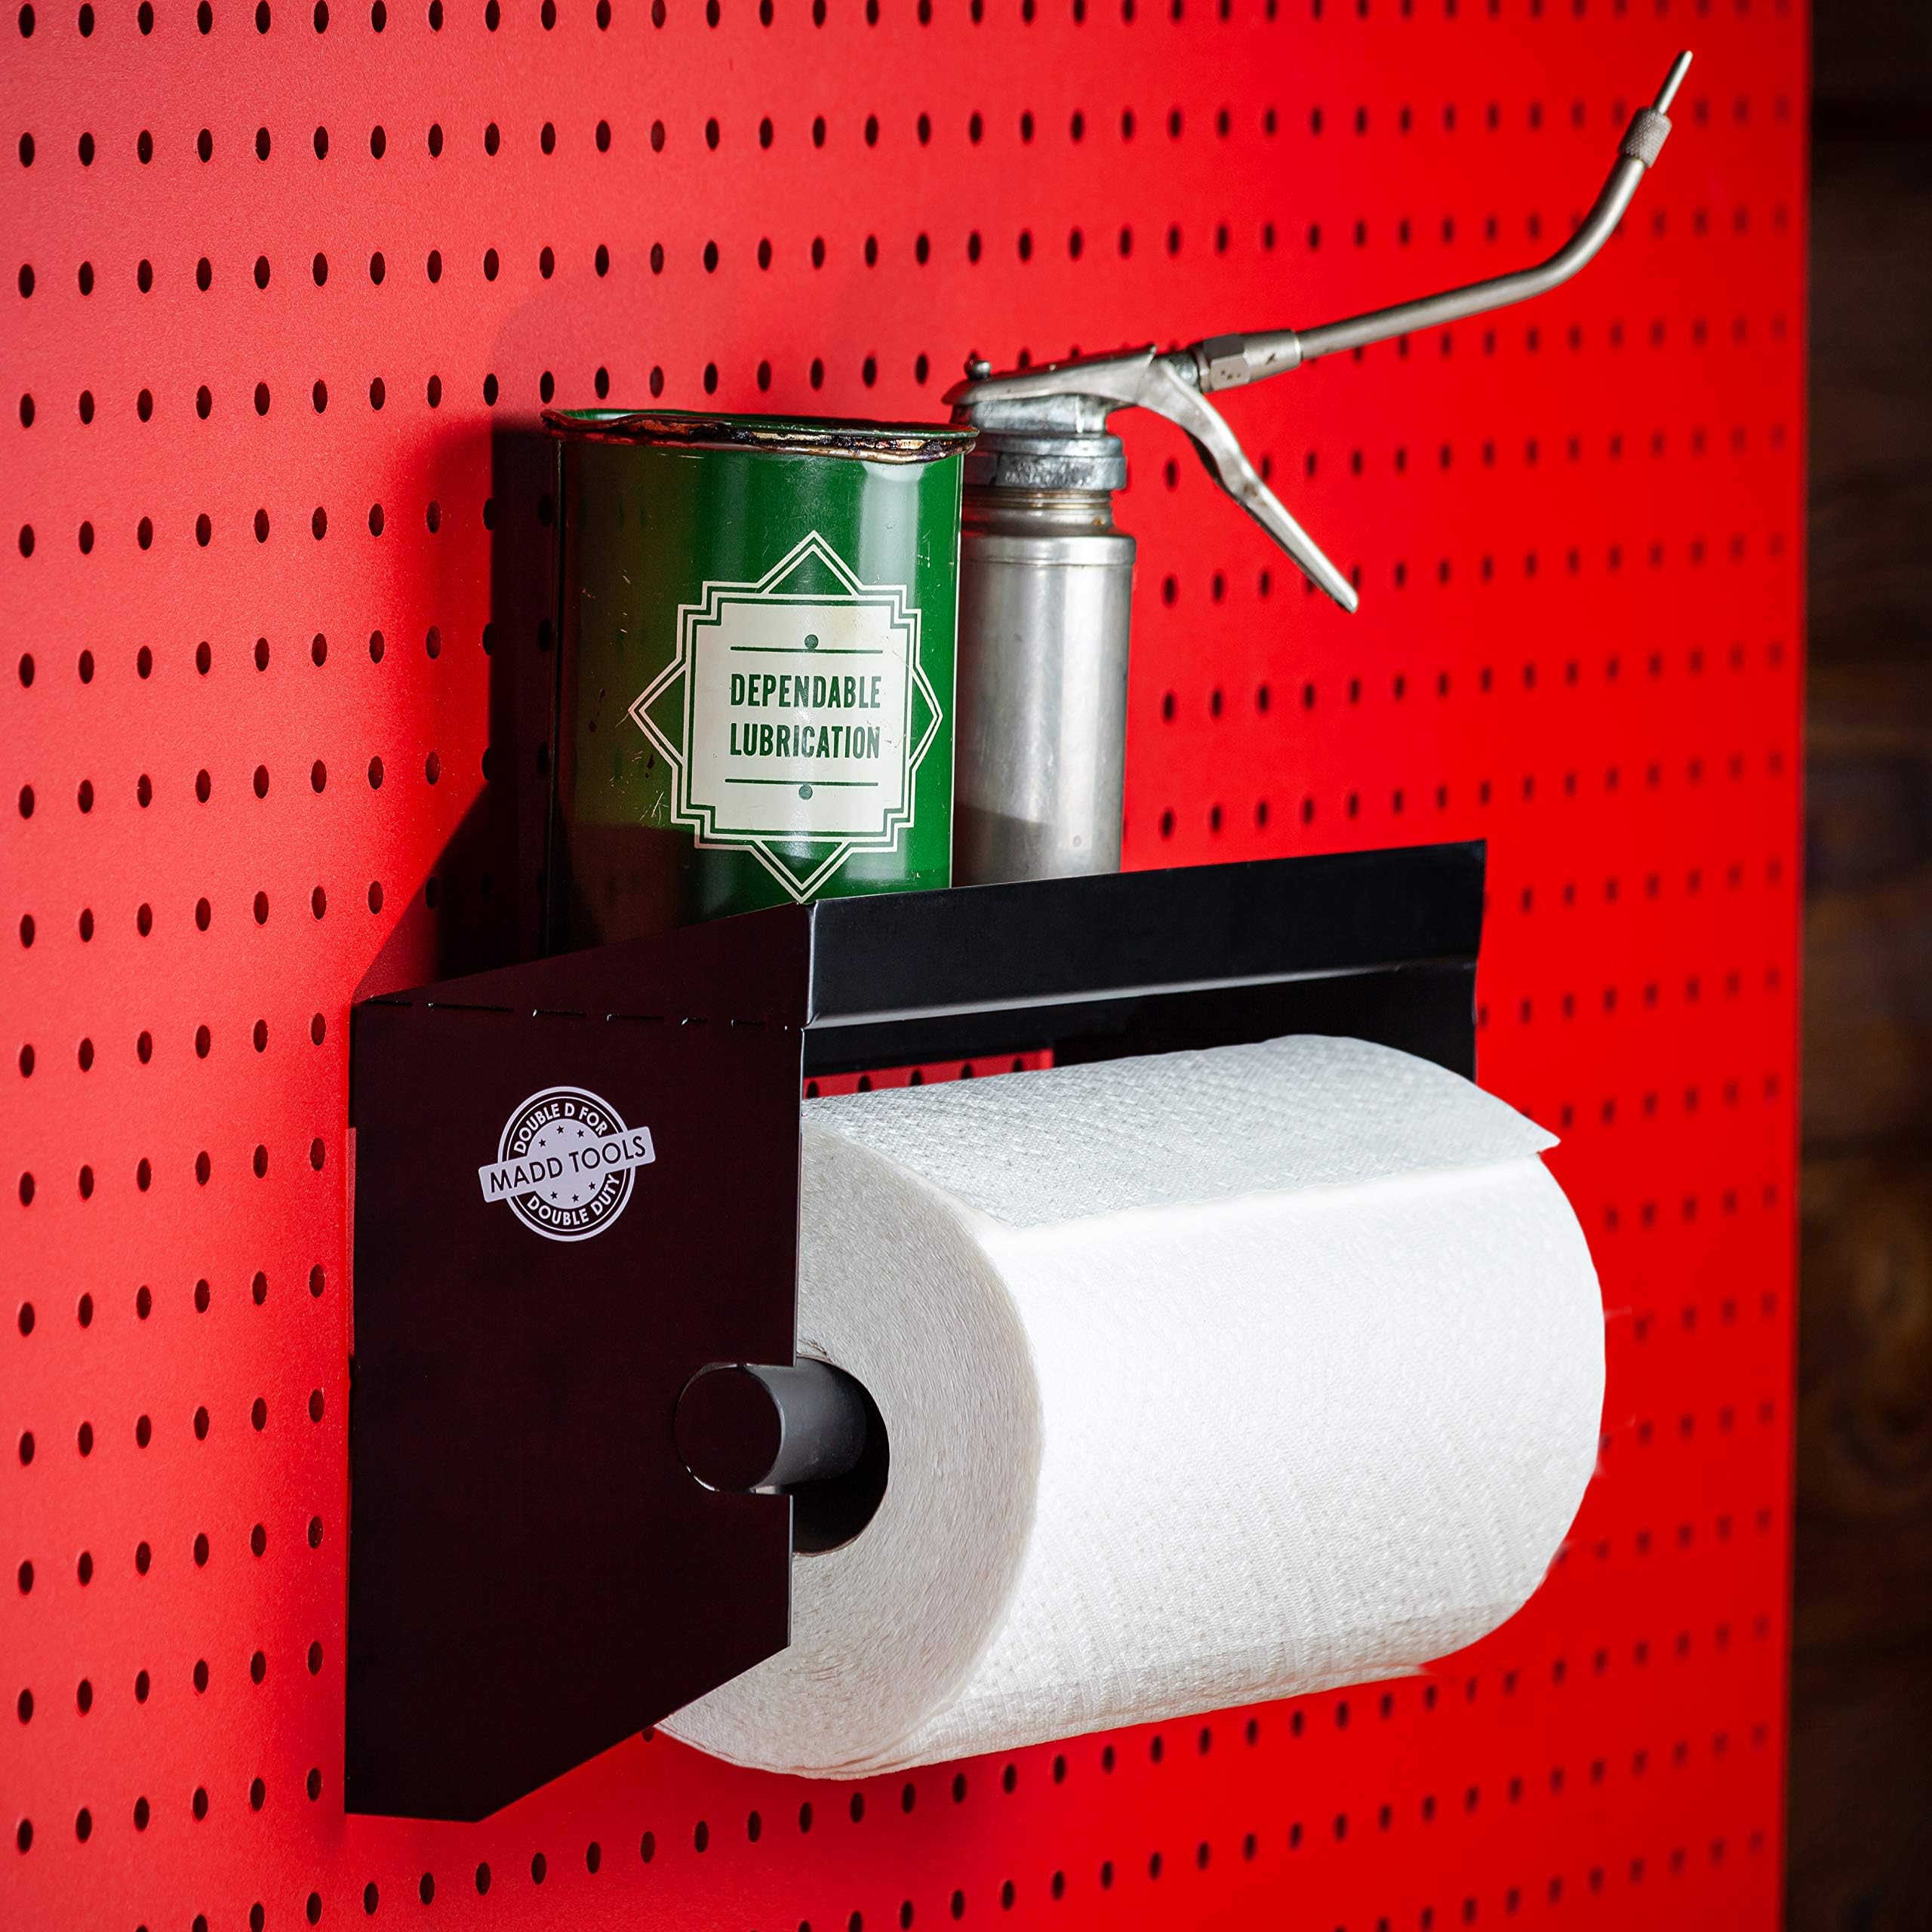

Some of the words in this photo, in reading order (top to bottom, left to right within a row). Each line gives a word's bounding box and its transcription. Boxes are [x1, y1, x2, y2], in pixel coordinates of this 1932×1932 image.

[730, 674, 881, 708] DEPENDABLE
[730, 722, 881, 758] LUBRICATION
[513, 1103, 561, 1154] DOUBLE
[565, 1103, 575, 1117] D
[579, 1106, 608, 1135] FOR
[491, 1157, 563, 1193] MADD
[568, 1136, 646, 1173] TOOLS
[527, 1195, 589, 1226] DOUBLE
[590, 1174, 620, 1216] DUTY
